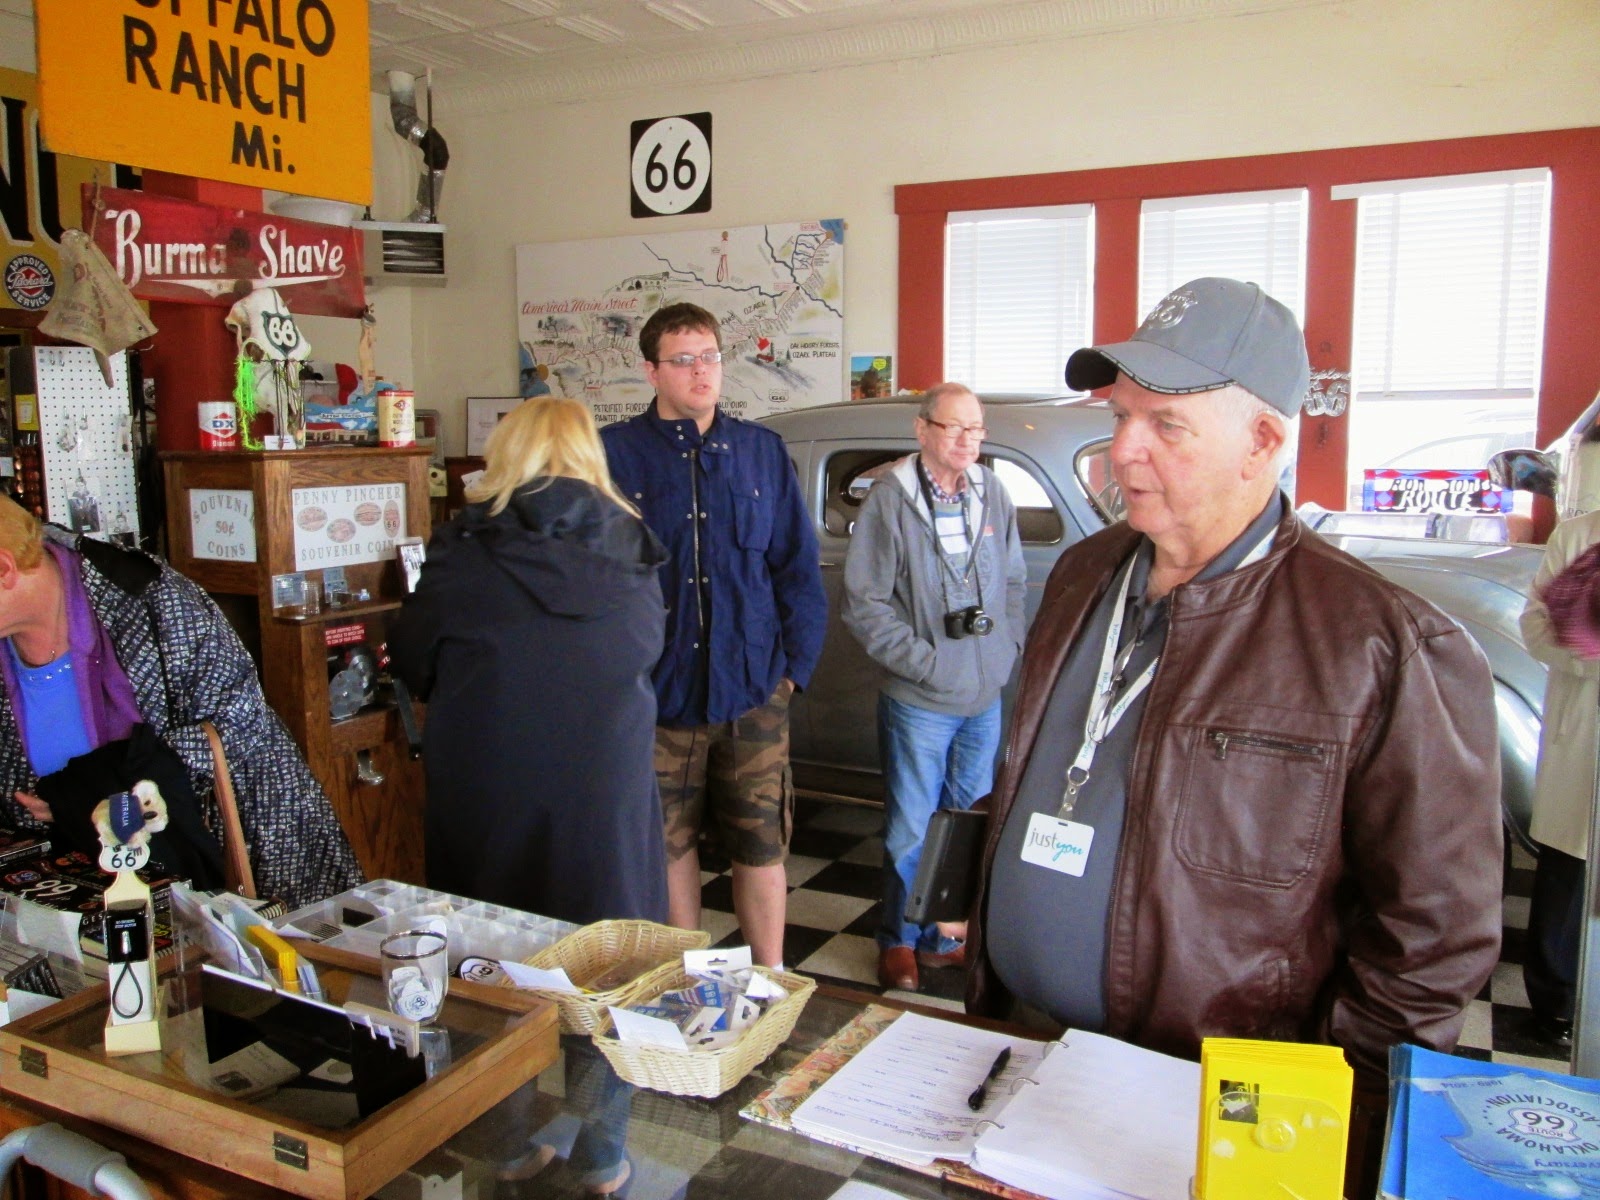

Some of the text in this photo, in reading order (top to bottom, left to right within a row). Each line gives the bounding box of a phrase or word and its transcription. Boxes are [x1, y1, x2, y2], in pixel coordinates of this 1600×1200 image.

[123, 14, 307, 124] RANCH
[231, 120, 296, 175] Mi.
[645, 138, 697, 194] 66
[104, 208, 347, 290] Burma Shave
[9, 256, 50, 275] APPROVED
[12, 290, 51, 308] SERVICE
[571, 300, 602, 313] Main
[605, 298, 638, 312] Street
[813, 350, 837, 358] PLATEAU
[594, 404, 623, 413] PETRIFIED
[294, 486, 401, 506] PENNY PINCHER
[208, 540, 246, 558] COINS
[301, 543, 361, 561] SOUVENIR
[111, 852, 137, 869] 66
[1486, 1093, 1600, 1123] ASSOCIATION
[1522, 1111, 1566, 1130] 66
[1495, 1127, 1600, 1156] OKLAHOMA
